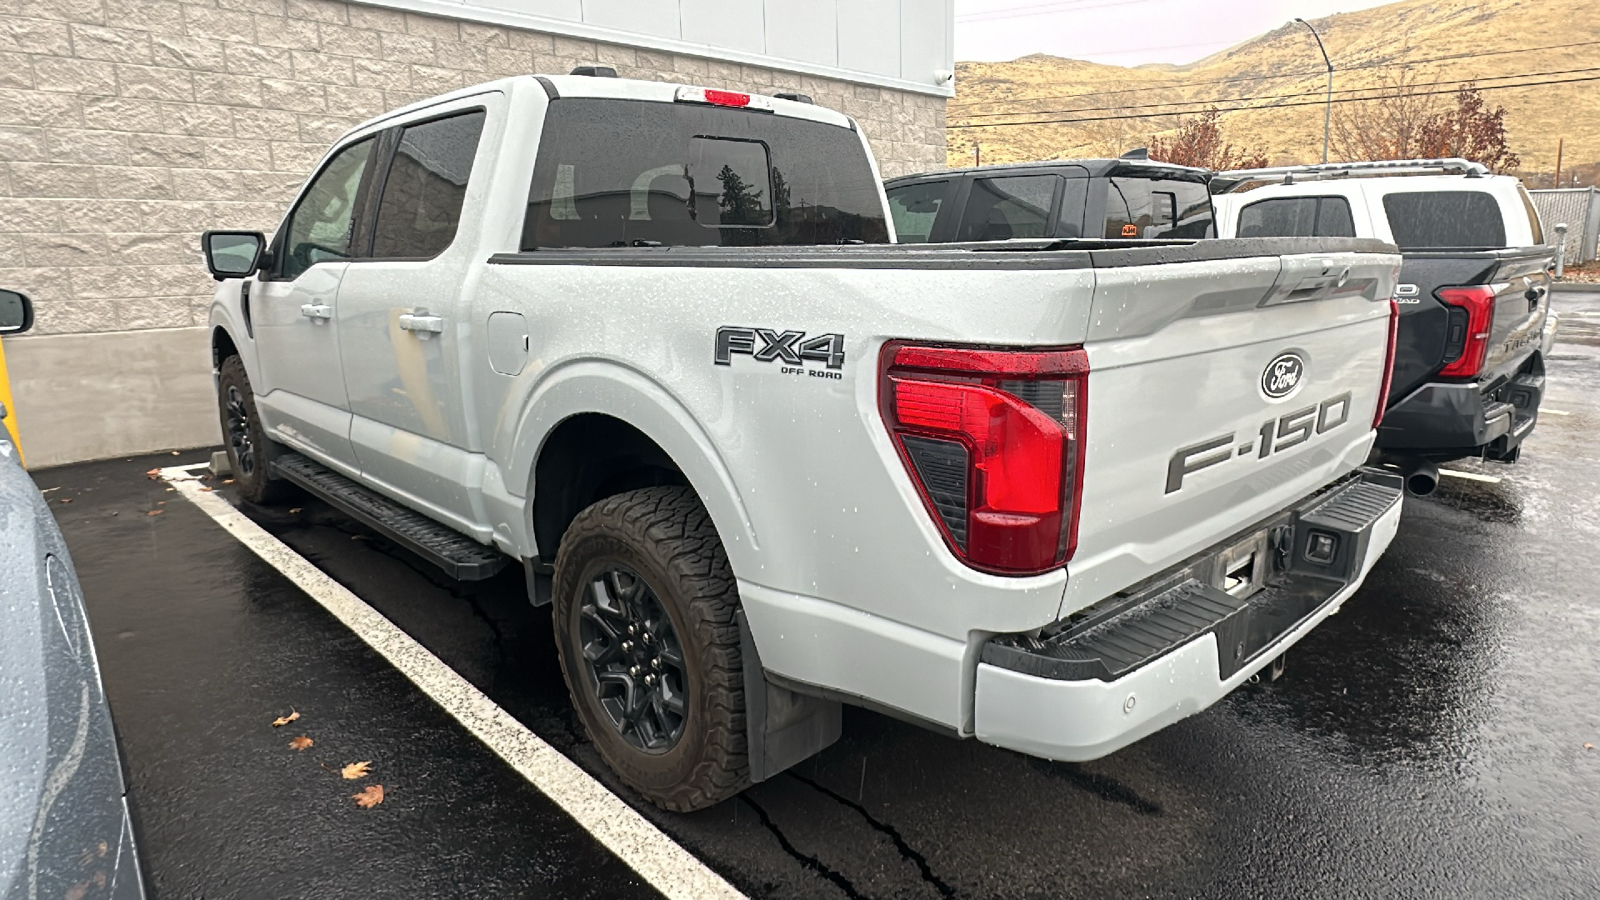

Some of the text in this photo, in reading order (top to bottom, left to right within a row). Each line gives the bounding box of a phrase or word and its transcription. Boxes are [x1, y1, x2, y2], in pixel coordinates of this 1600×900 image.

[714, 325, 845, 370] FX4
[781, 366, 843, 380] OFF ROAD
[1269, 360, 1300, 392] Ford
[1164, 391, 1353, 495] F-150
